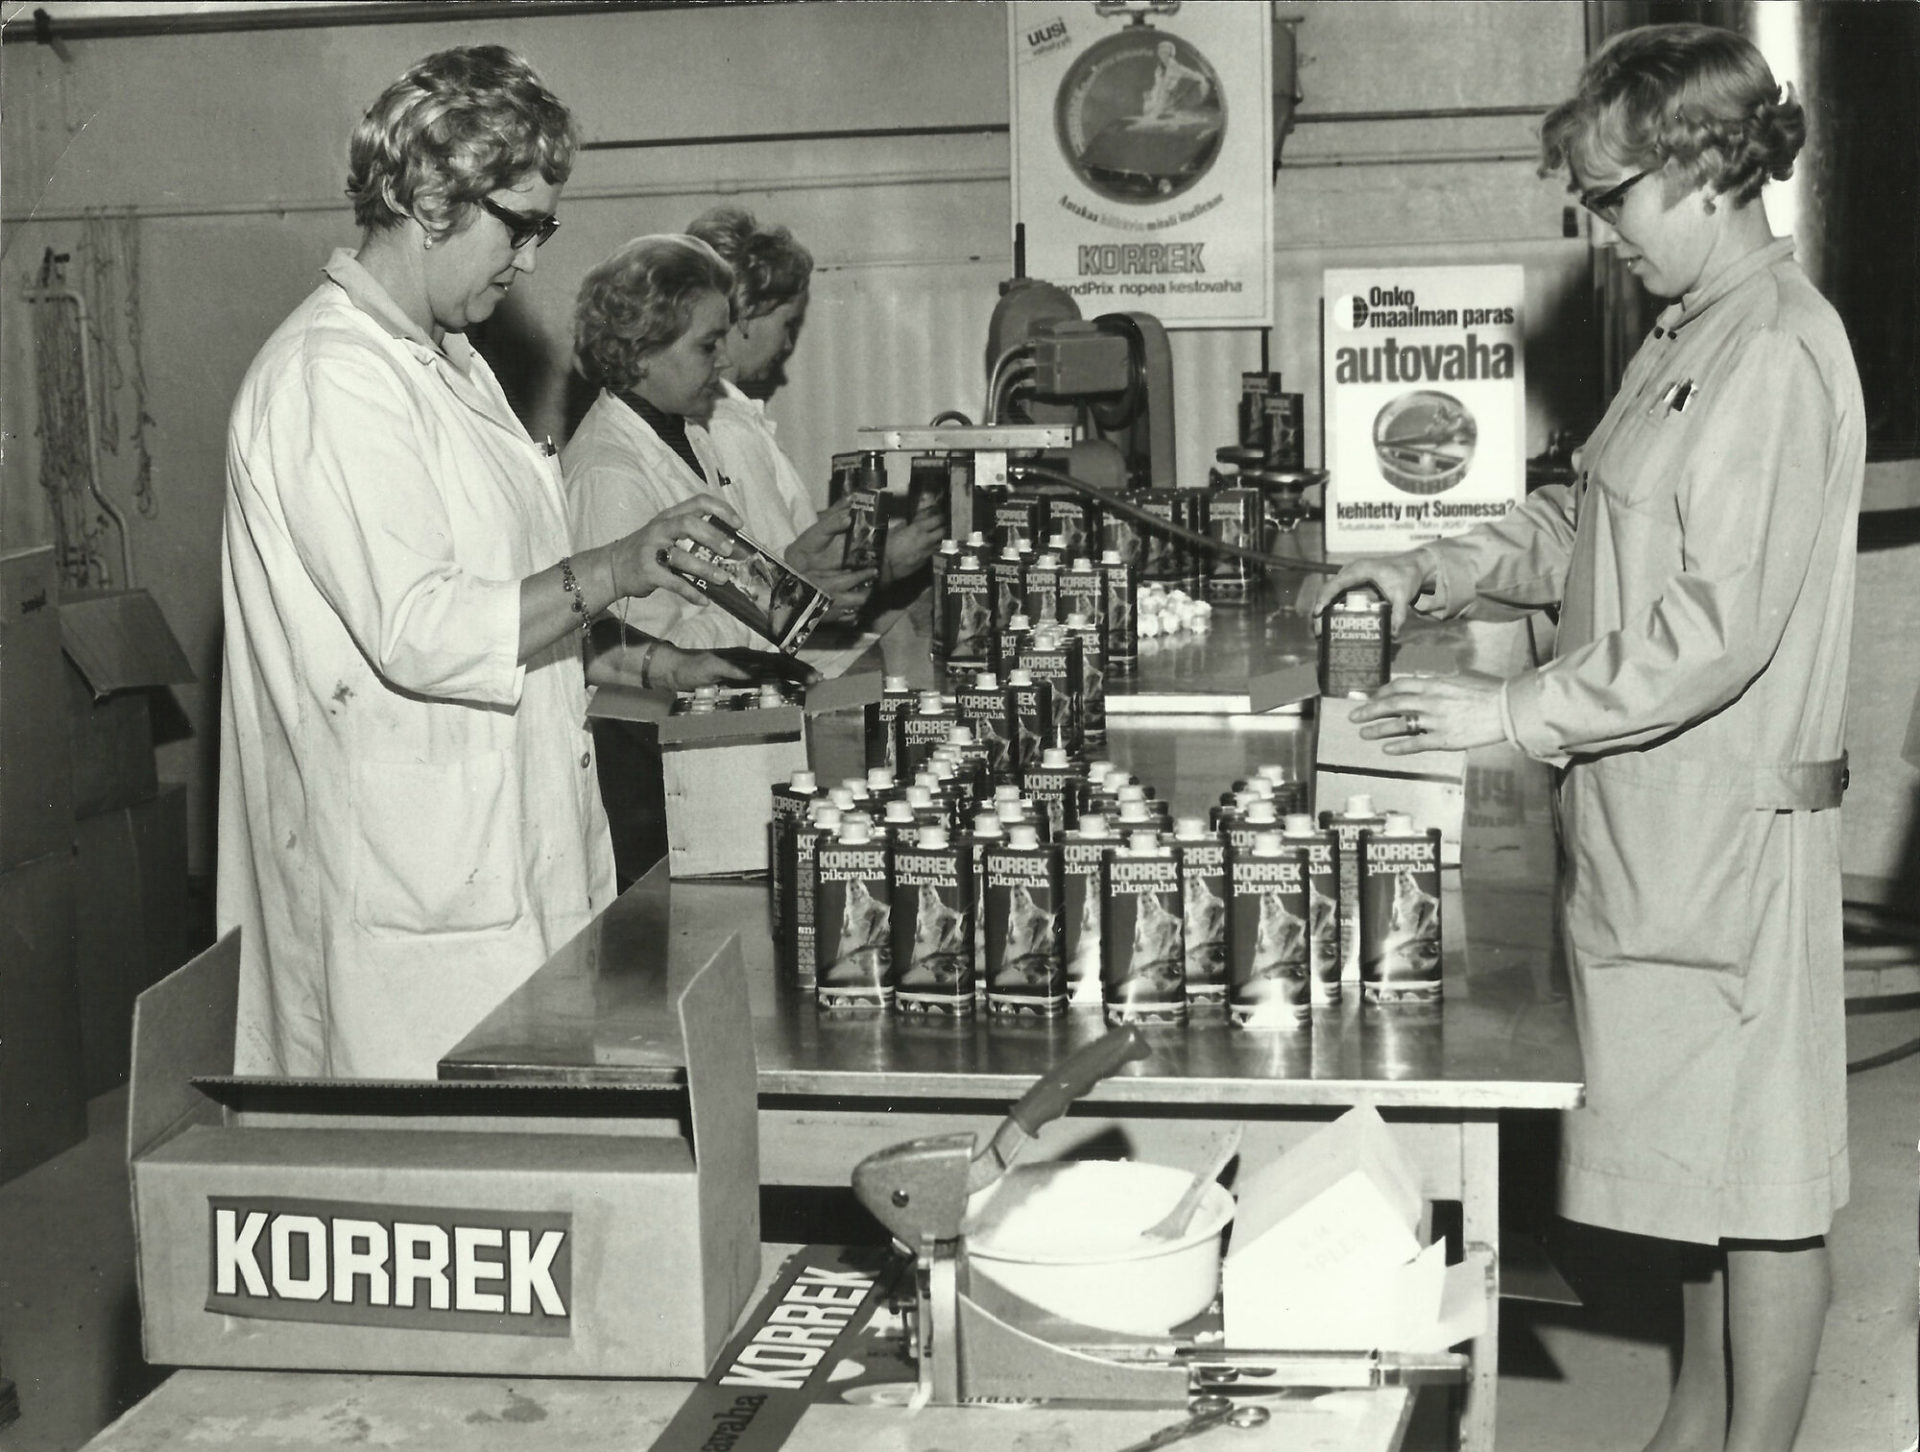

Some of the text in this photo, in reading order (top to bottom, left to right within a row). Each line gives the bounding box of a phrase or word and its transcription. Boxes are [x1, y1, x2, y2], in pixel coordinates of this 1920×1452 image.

[1027, 17, 1067, 47] uusi
[1078, 242, 1206, 276] KORREK
[1120, 281, 1166, 296] nopea
[1169, 279, 1243, 294] kestovaha
[1369, 286, 1415, 307] Onko
[1370, 307, 1514, 329] maailman paras
[1336, 333, 1514, 383] autovaha
[1337, 499, 1515, 521] kehitetty nyt Suomessa?
[947, 574, 987, 585] KORREK
[1060, 576, 1101, 589] KORREK
[1330, 617, 1381, 630] KORREK
[1019, 656, 1067, 669] KORREK
[819, 851, 885, 869] KORREK
[1366, 843, 1434, 861] KORREK
[895, 855, 957, 875] KORREK
[987, 856, 1048, 876] KORREK
[1110, 863, 1177, 880] KORREK
[1232, 863, 1300, 881] KORREK
[1367, 862, 1435, 876] pikavaha
[820, 869, 886, 883] pikavaha
[895, 873, 957, 887] pikavaha
[988, 873, 1049, 888] pikavaha
[1111, 881, 1178, 897] pikavaha
[1233, 882, 1301, 897] pikavaha
[216, 1209, 567, 1317] KORREK
[718, 1265, 880, 1389] KORREK
